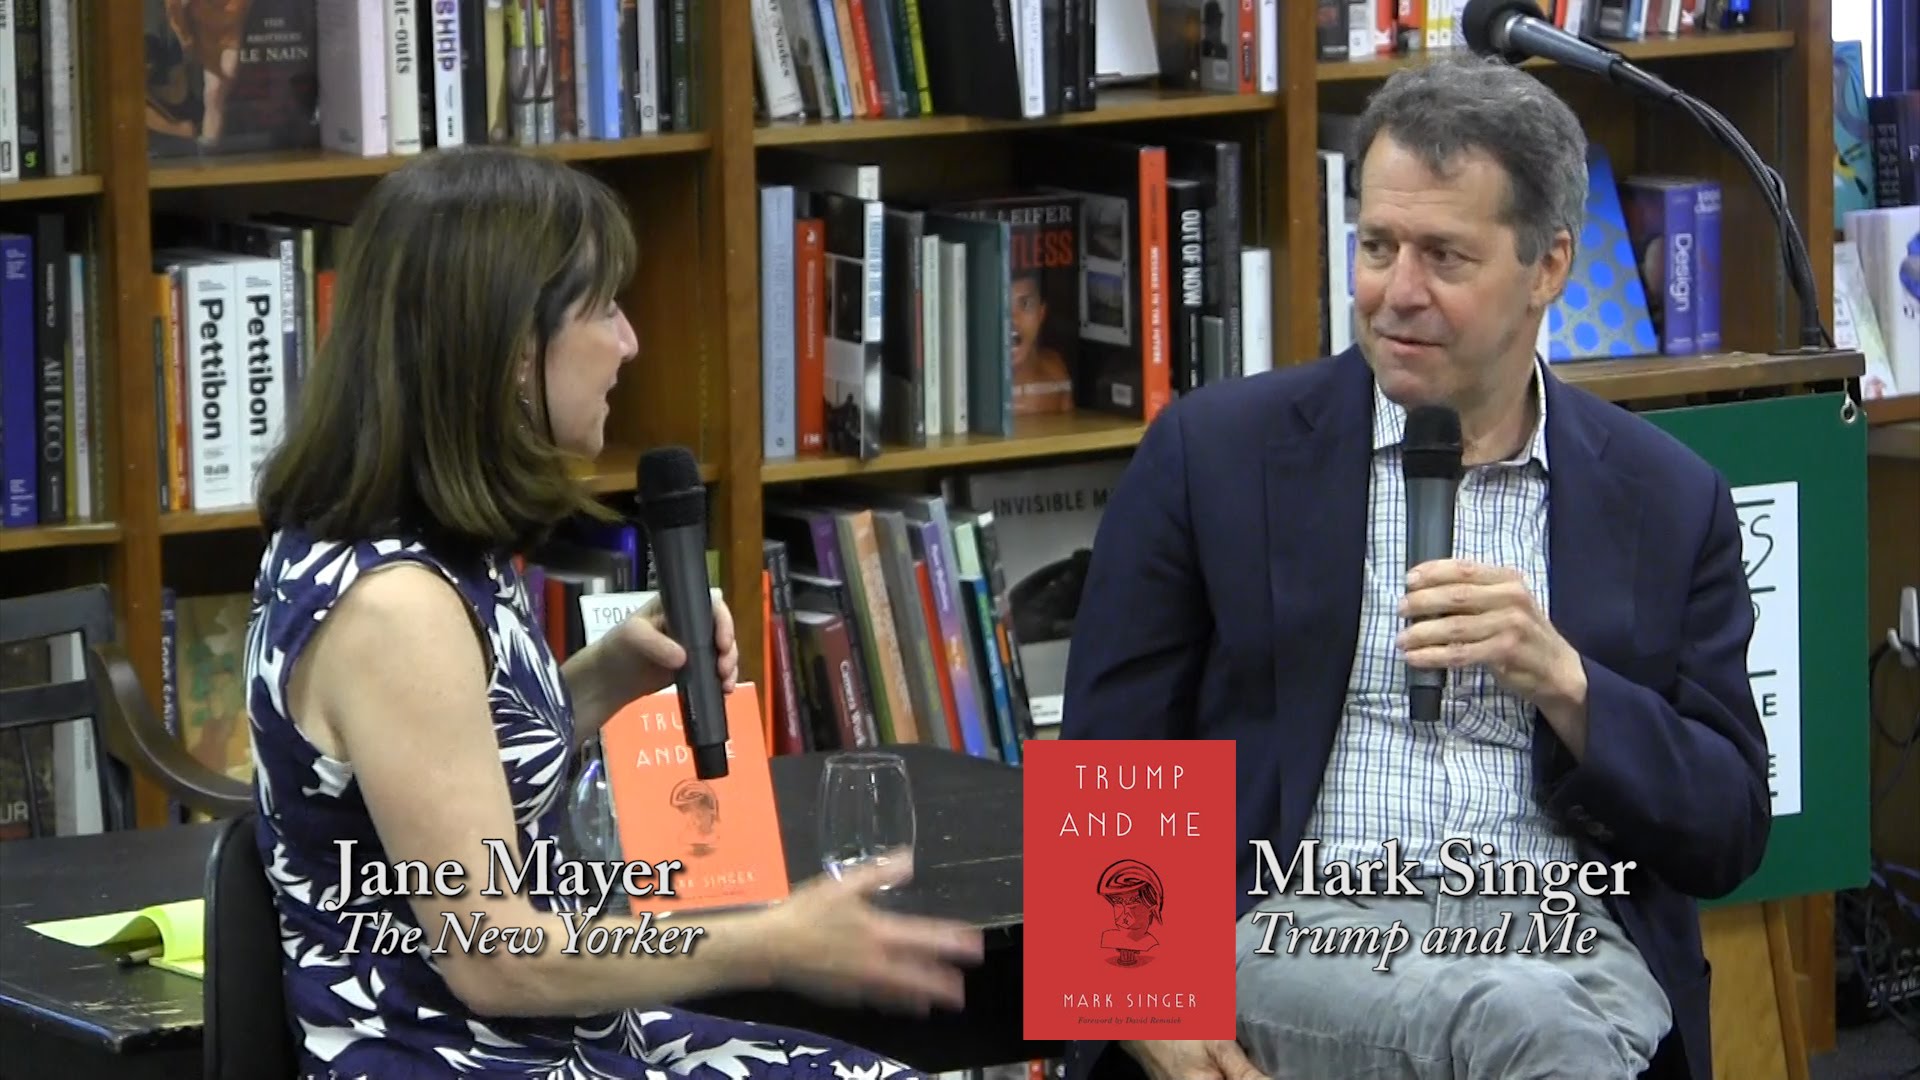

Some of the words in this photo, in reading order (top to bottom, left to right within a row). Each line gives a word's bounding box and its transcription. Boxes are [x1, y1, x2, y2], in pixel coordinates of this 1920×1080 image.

[240, 47, 260, 63] LE
[266, 45, 309, 62] NAIN
[1180, 208, 1202, 242] OUT
[1181, 243, 1203, 264] OF
[1182, 267, 1203, 306] NOW
[1669, 233, 1693, 312] Design
[198, 297, 227, 441] Pettibon
[245, 294, 274, 436] Pettibon
[992, 489, 1086, 518] INVISIBLE
[639, 712, 685, 733] TRU
[636, 745, 689, 768] AND
